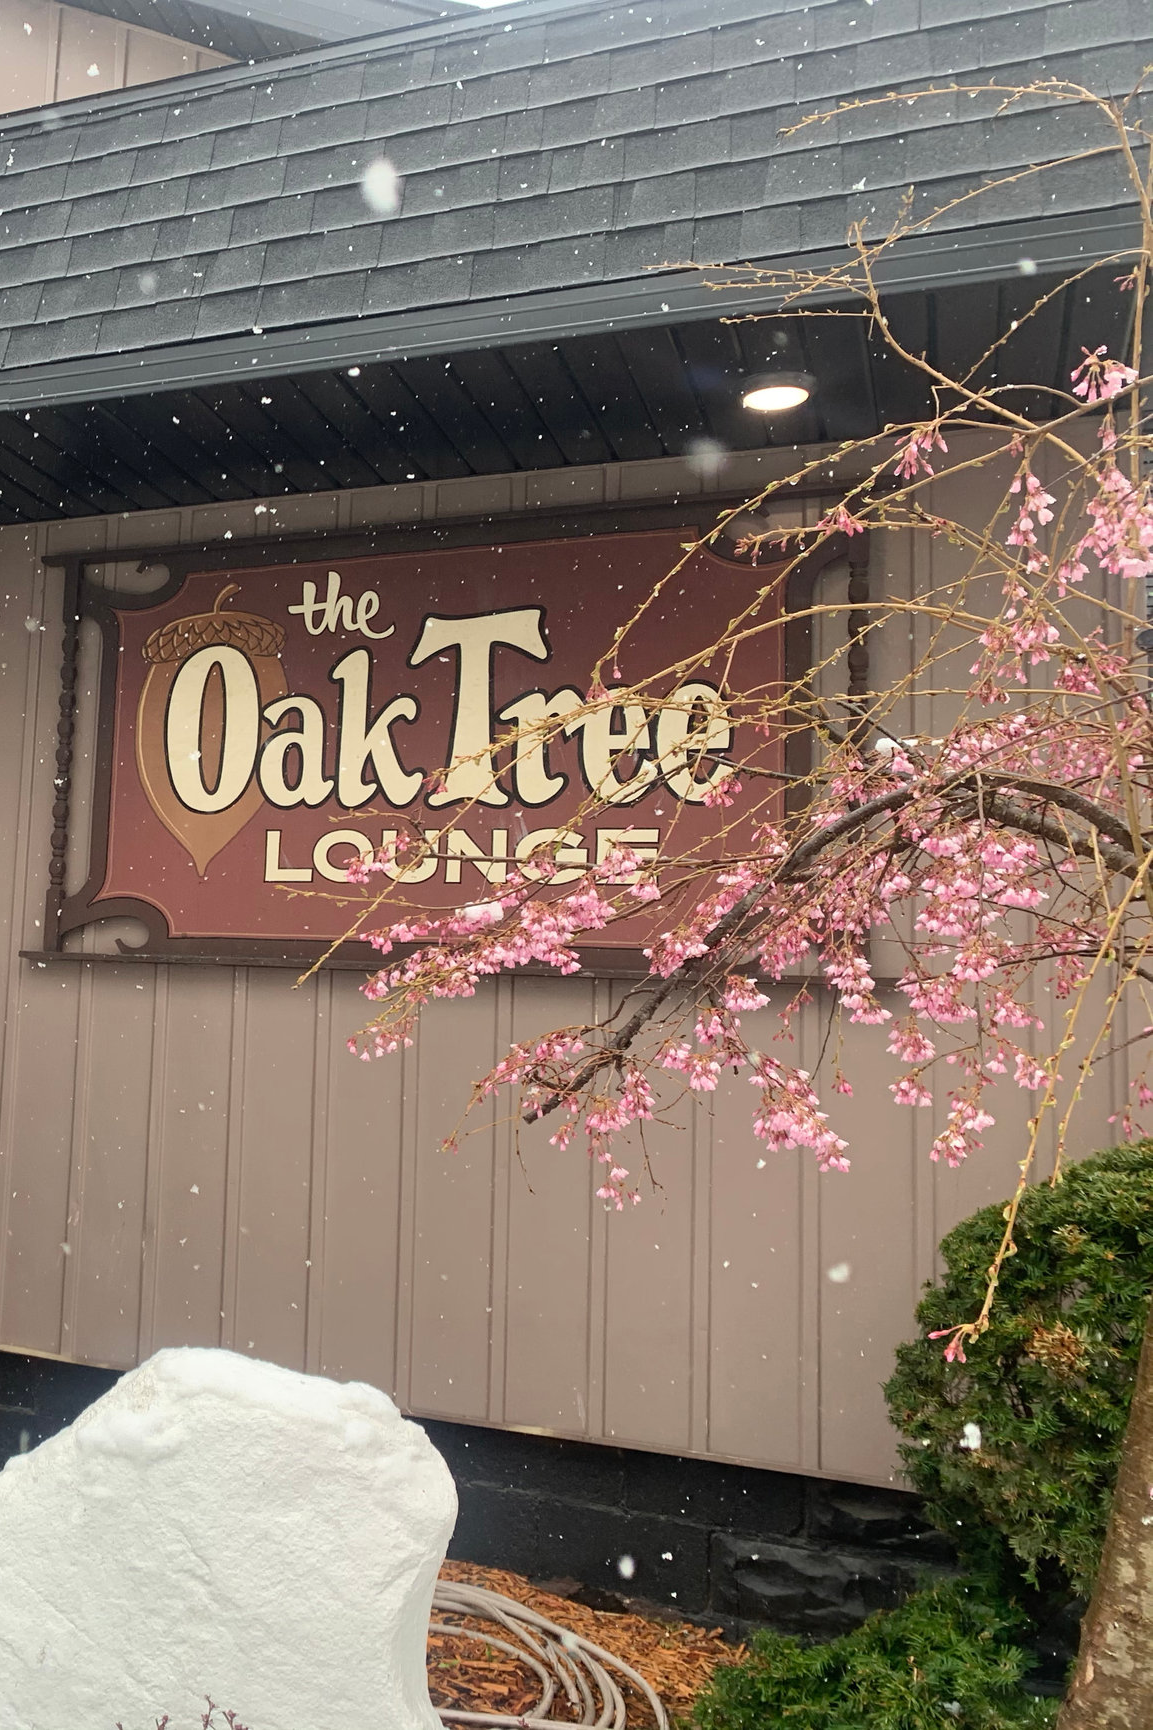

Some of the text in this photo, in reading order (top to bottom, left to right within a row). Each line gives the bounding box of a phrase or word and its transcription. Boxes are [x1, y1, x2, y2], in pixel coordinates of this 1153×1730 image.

[288, 571, 395, 638] the
[165, 605, 739, 814] Oak Tree
[264, 828, 661, 885] LOUNGE
